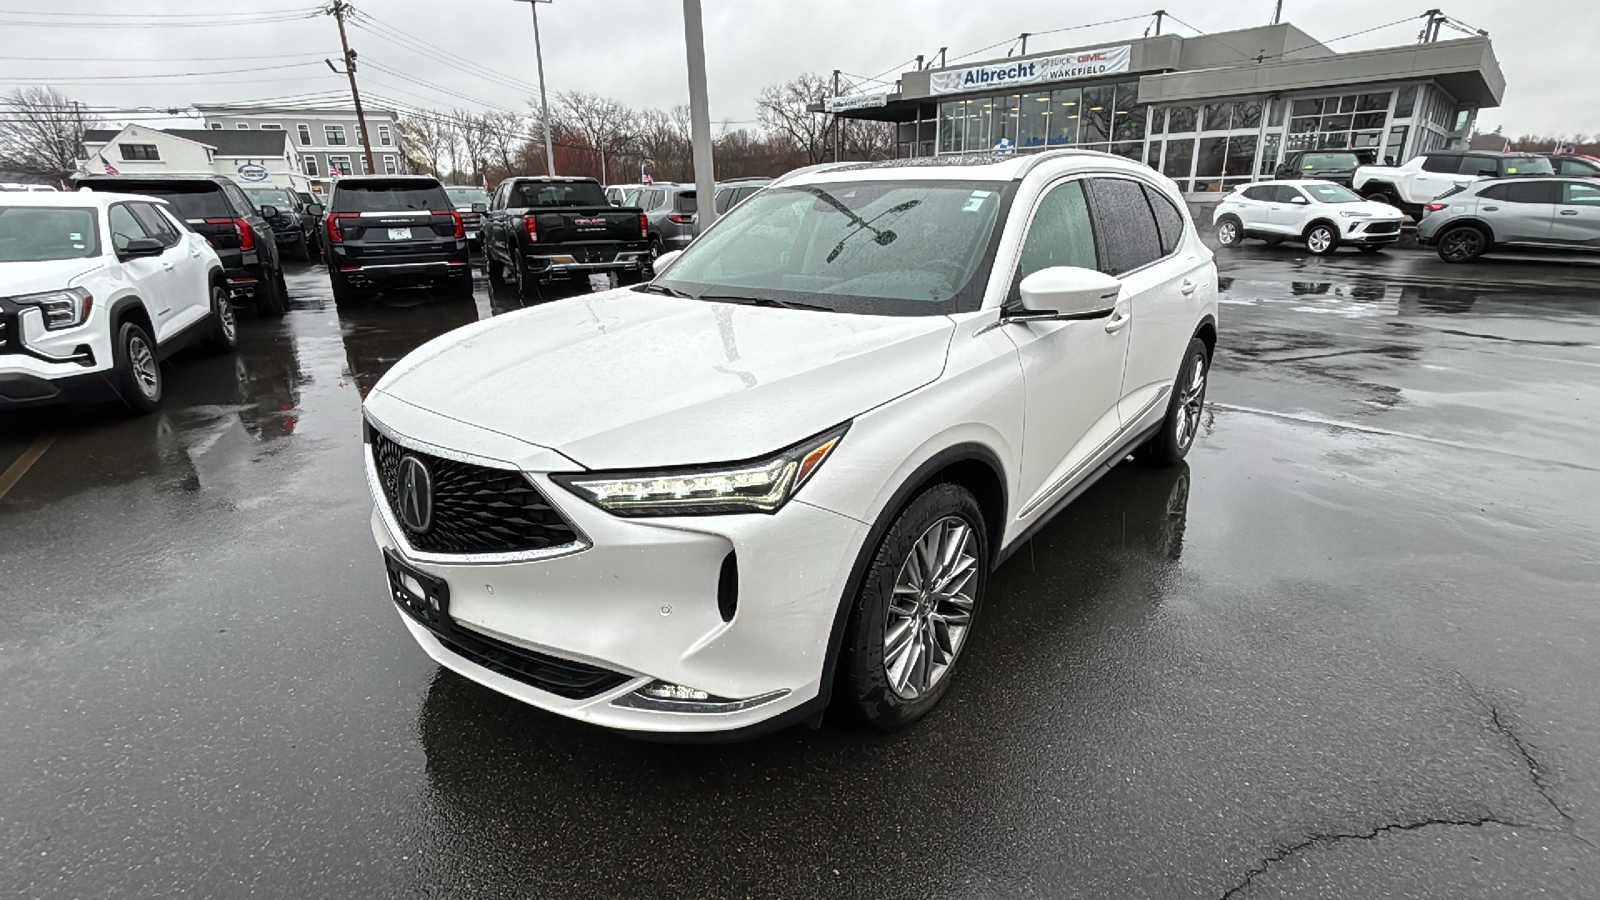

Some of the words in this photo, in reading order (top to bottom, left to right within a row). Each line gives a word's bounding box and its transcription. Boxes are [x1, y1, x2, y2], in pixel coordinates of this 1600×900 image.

[1050, 57, 1071, 67] BUICK
[1077, 52, 1107, 64] GMC
[964, 61, 1036, 85] Albrecht
[1050, 64, 1106, 79] WAKEFIELD
